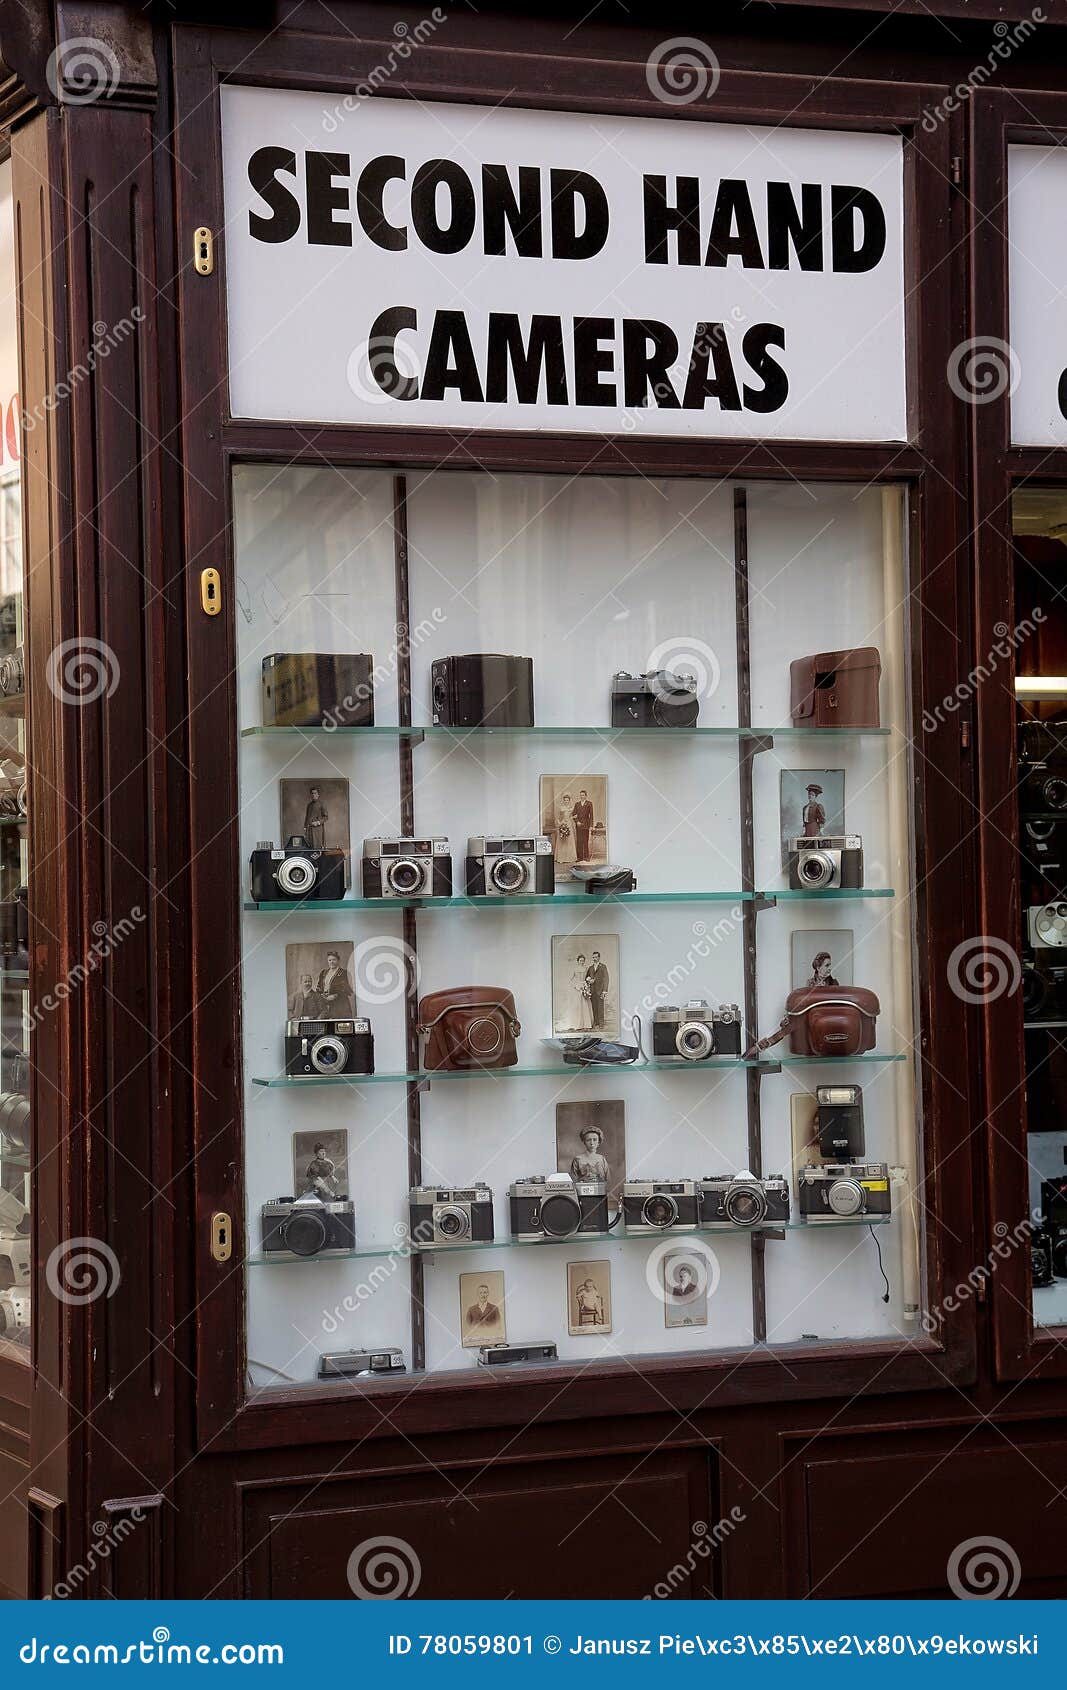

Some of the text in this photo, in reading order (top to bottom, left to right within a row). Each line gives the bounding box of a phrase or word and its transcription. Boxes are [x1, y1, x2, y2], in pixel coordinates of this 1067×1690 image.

[247, 146, 887, 274] SECOND HAND
[366, 306, 790, 414] CAMERAS
